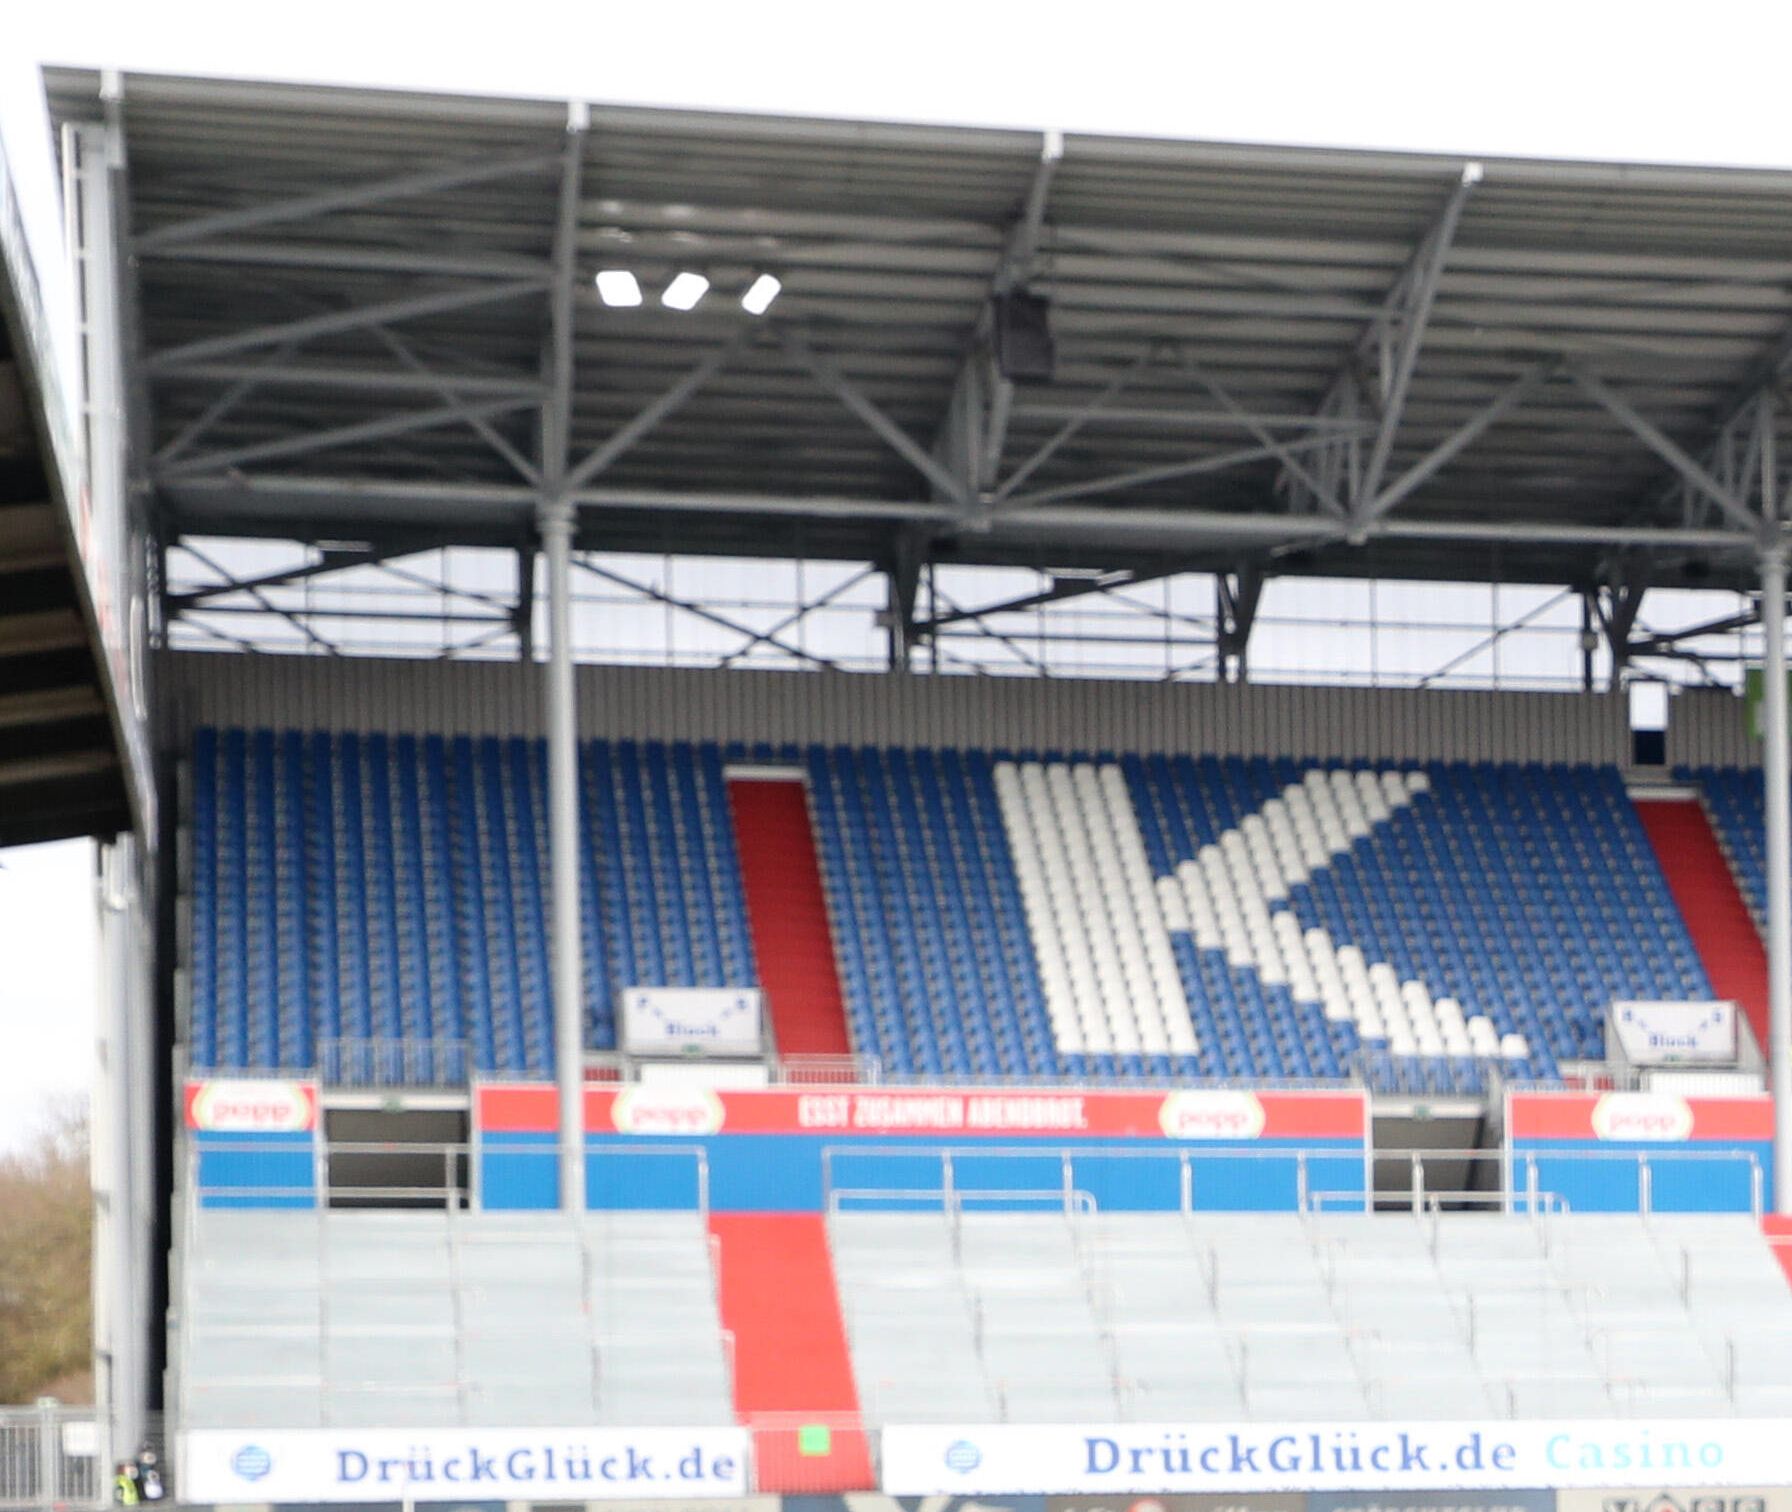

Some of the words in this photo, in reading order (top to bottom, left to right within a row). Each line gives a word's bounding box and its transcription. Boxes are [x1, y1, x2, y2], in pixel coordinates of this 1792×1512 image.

[337, 1445, 737, 1483] DrückGlück.de
[1084, 1432, 1517, 1475] DrückGlück.de
[1544, 1431, 1725, 1471] Casino
